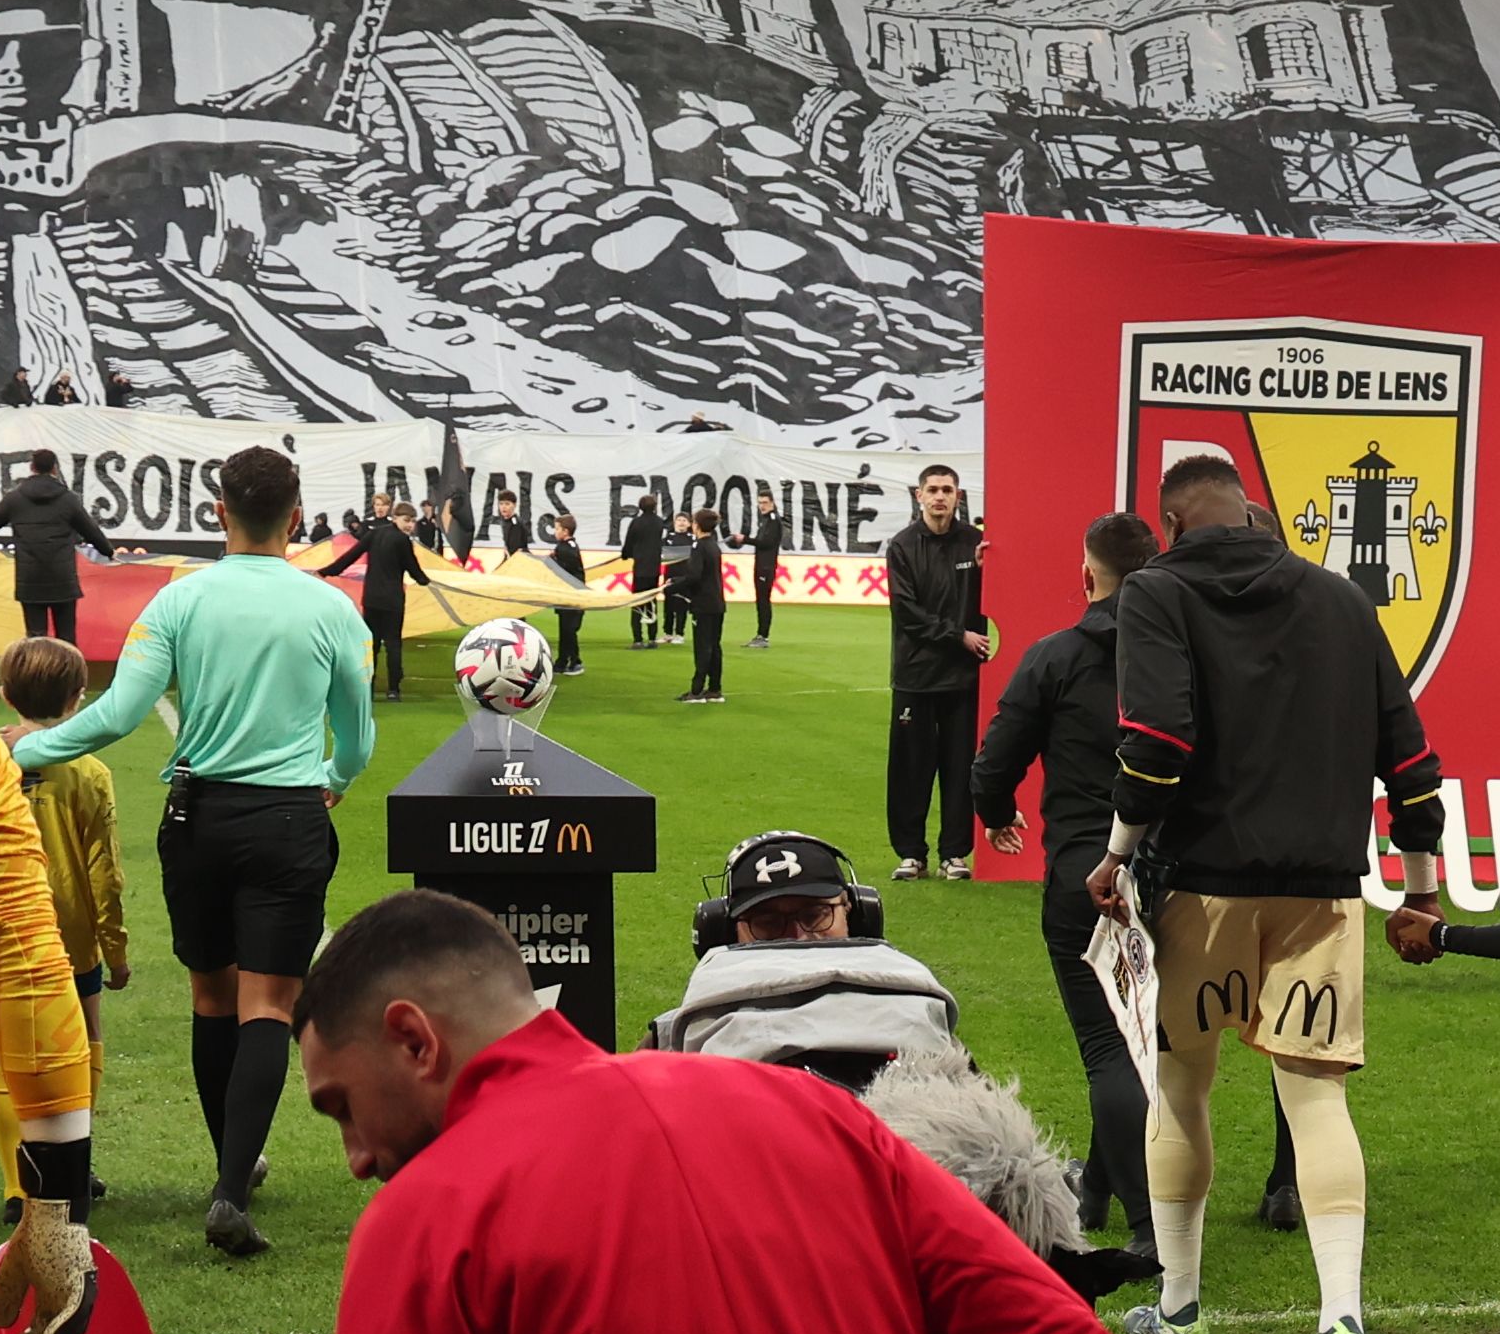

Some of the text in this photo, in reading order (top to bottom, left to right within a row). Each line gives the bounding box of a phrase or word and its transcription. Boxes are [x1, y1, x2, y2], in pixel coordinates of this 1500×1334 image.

[1277, 347, 1324, 364] 1906
[1151, 362, 1448, 402] RACING CLUB DE LENS
[491, 777, 531, 786] LIGUE
[450, 822, 524, 854] LIGUE
[521, 938, 590, 964] atch
